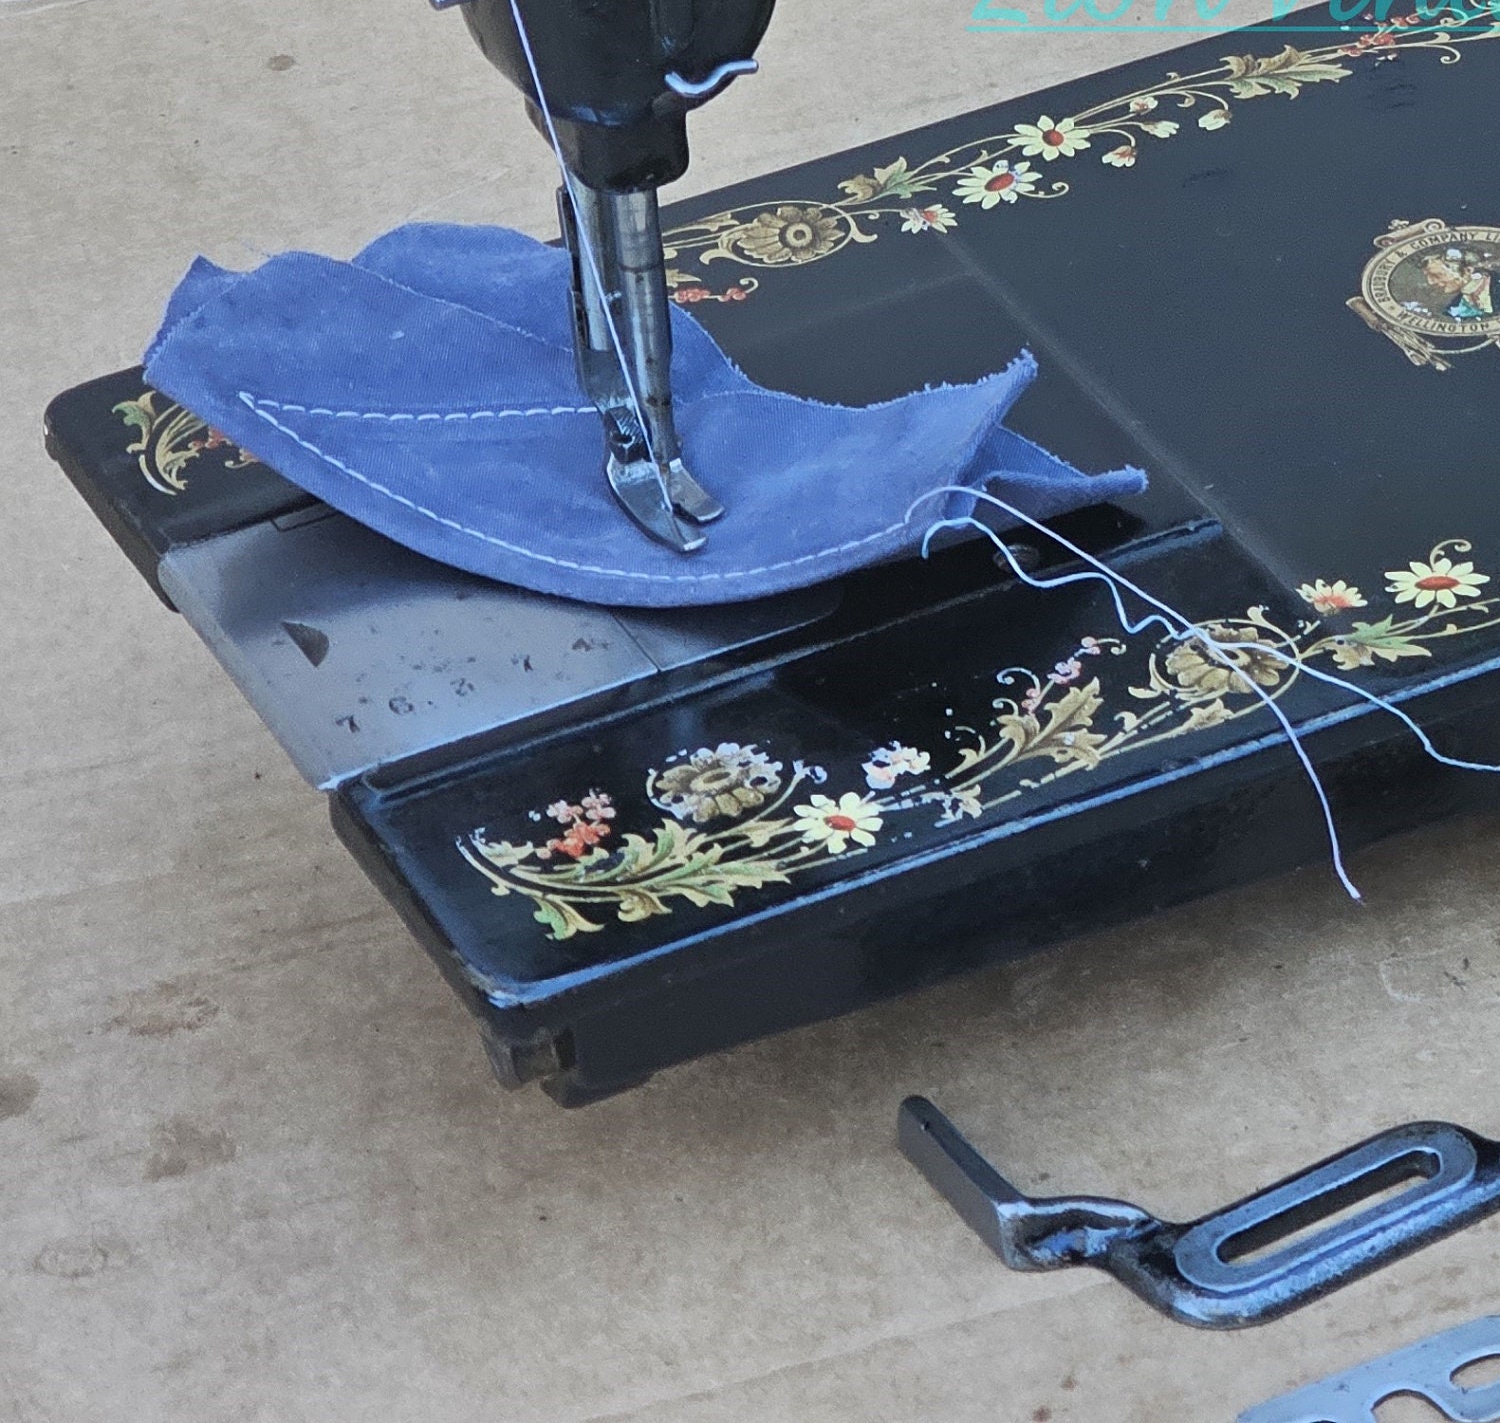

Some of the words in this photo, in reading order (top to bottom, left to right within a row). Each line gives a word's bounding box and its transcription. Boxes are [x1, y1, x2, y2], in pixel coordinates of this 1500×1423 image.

[1372, 257, 1396, 304] BRADBURY
[1410, 230, 1476, 251] COMPANY
[1397, 310, 1490, 333] WELLINGTON
